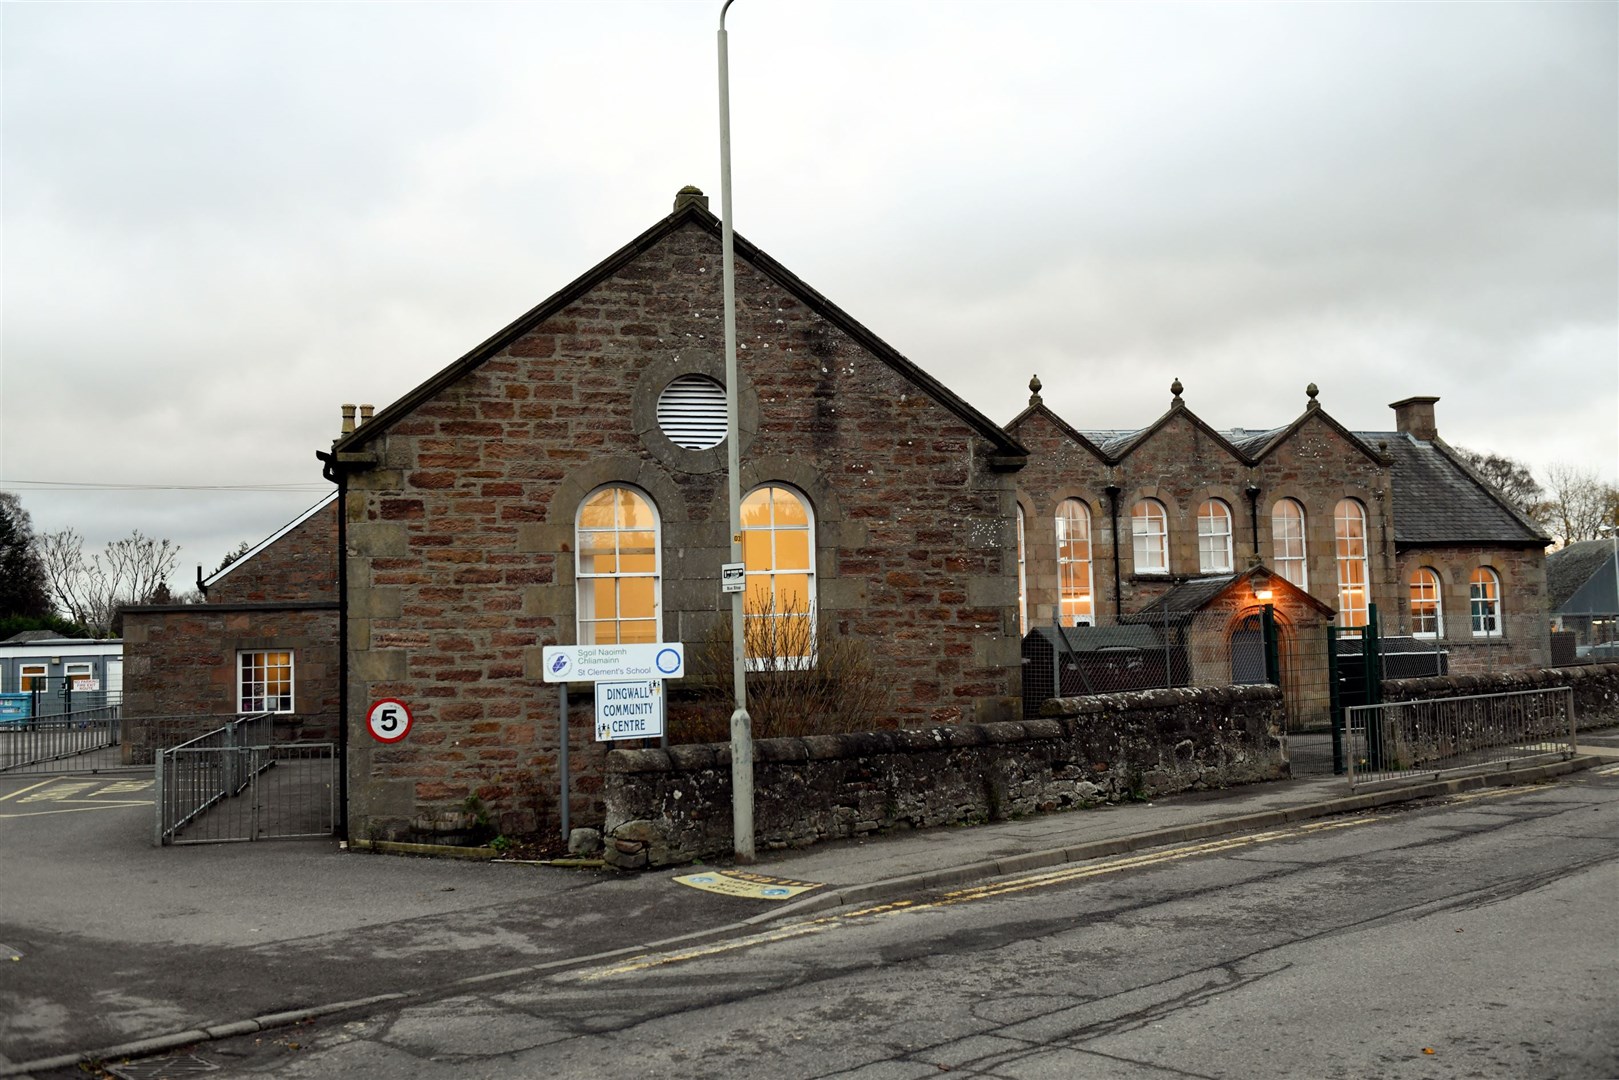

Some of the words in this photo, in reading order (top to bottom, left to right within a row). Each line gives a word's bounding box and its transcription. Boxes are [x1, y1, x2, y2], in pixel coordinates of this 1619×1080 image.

[577, 649, 597, 658] Sgoil
[598, 648, 627, 656] Naoimh
[577, 657, 620, 665] Chliamainn
[577, 668, 586, 676] St
[587, 667, 624, 676] Clement's
[625, 666, 651, 675] School
[607, 687, 649, 700] DINGWALL
[603, 703, 653, 717] COMMUNITY
[380, 709, 398, 732] 5
[612, 719, 646, 732] CENTRE
